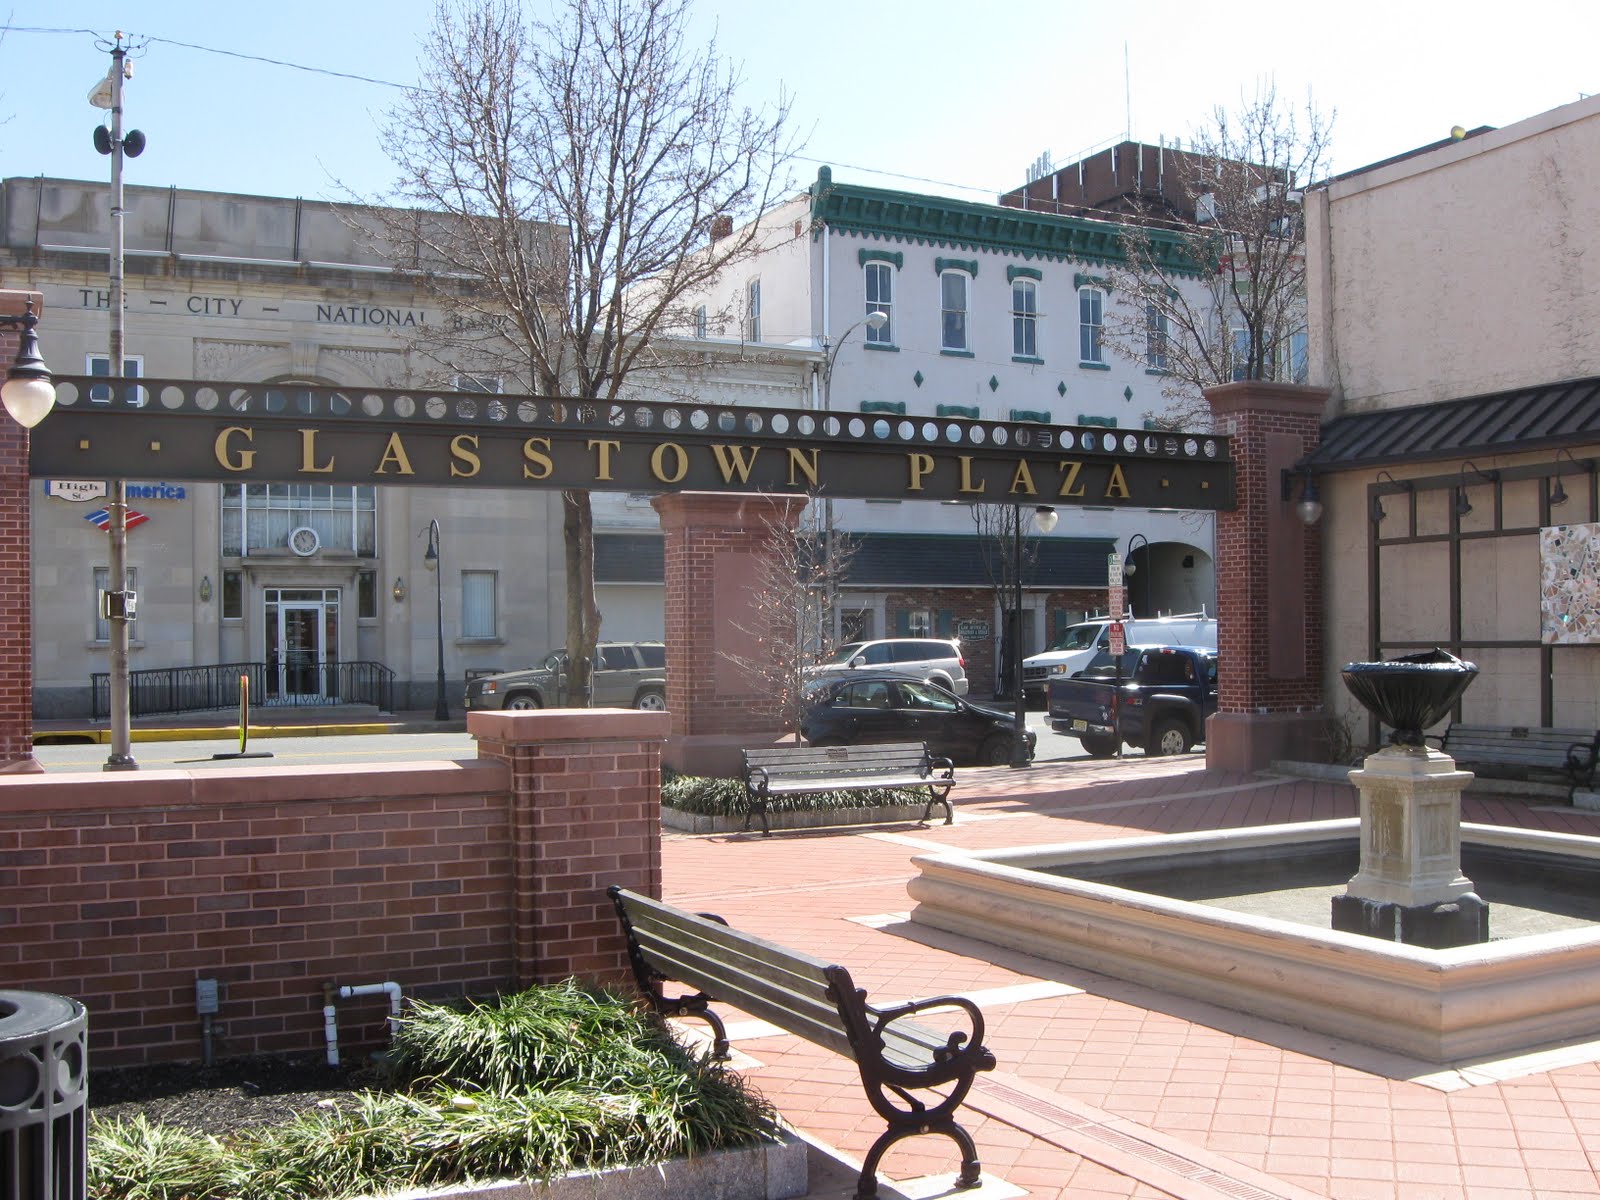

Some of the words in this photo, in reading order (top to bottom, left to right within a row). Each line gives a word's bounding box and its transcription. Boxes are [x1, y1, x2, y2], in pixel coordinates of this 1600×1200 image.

[186, 296, 243, 316] CITY
[214, 426, 821, 487] GLASSTOWN
[906, 452, 1131, 499] PLAZA
[58, 482, 99, 492] High
[125, 481, 186, 500] merica
